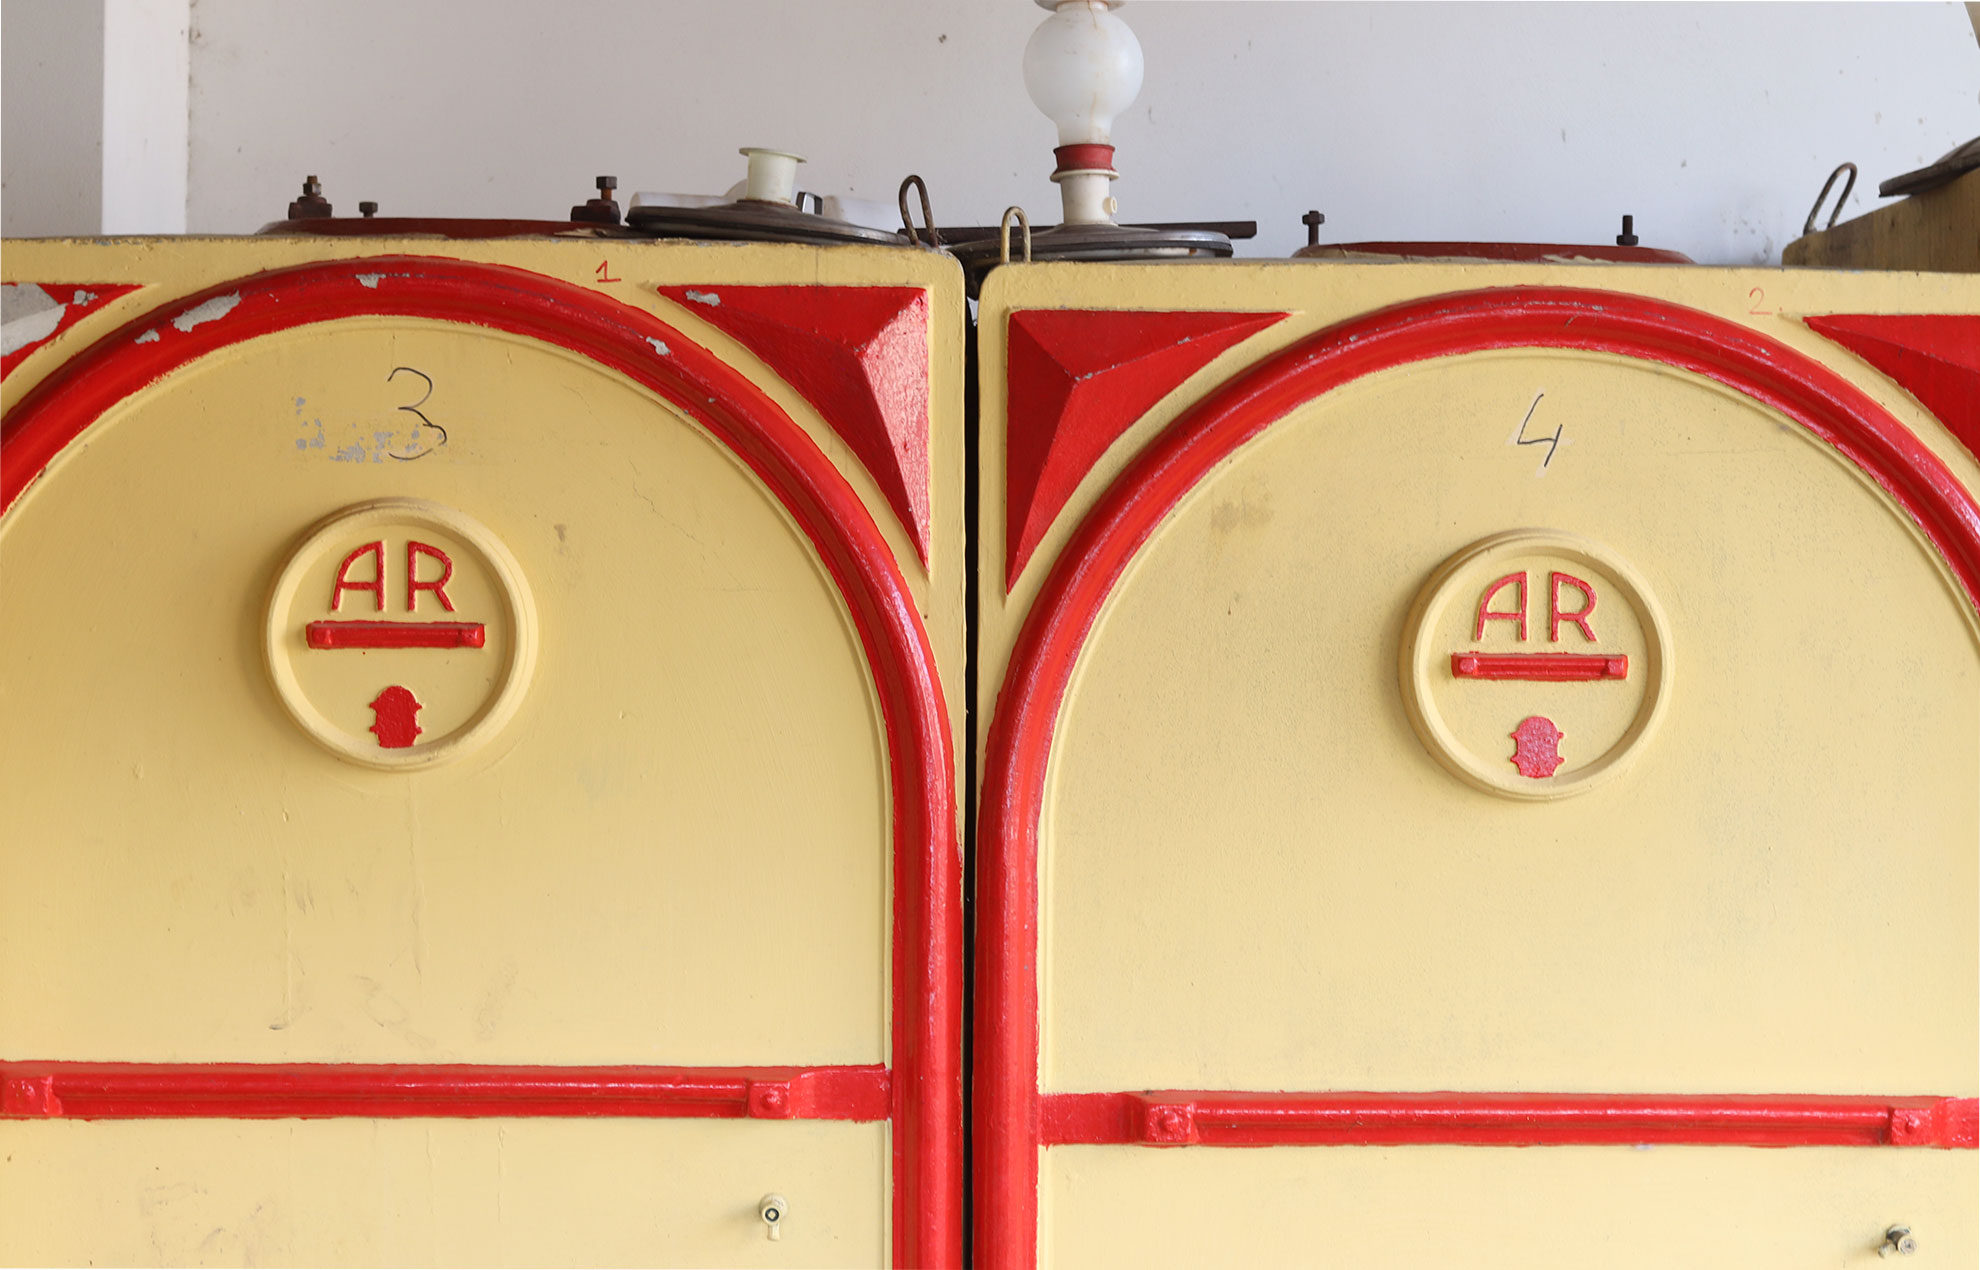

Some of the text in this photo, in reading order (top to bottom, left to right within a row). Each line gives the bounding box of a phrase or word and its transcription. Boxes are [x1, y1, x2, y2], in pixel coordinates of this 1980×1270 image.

[595, 260, 622, 283] 1
[387, 367, 447, 461] 3
[1517, 393, 1563, 467] 4
[331, 540, 456, 612] AR
[1476, 571, 1597, 642] AR
